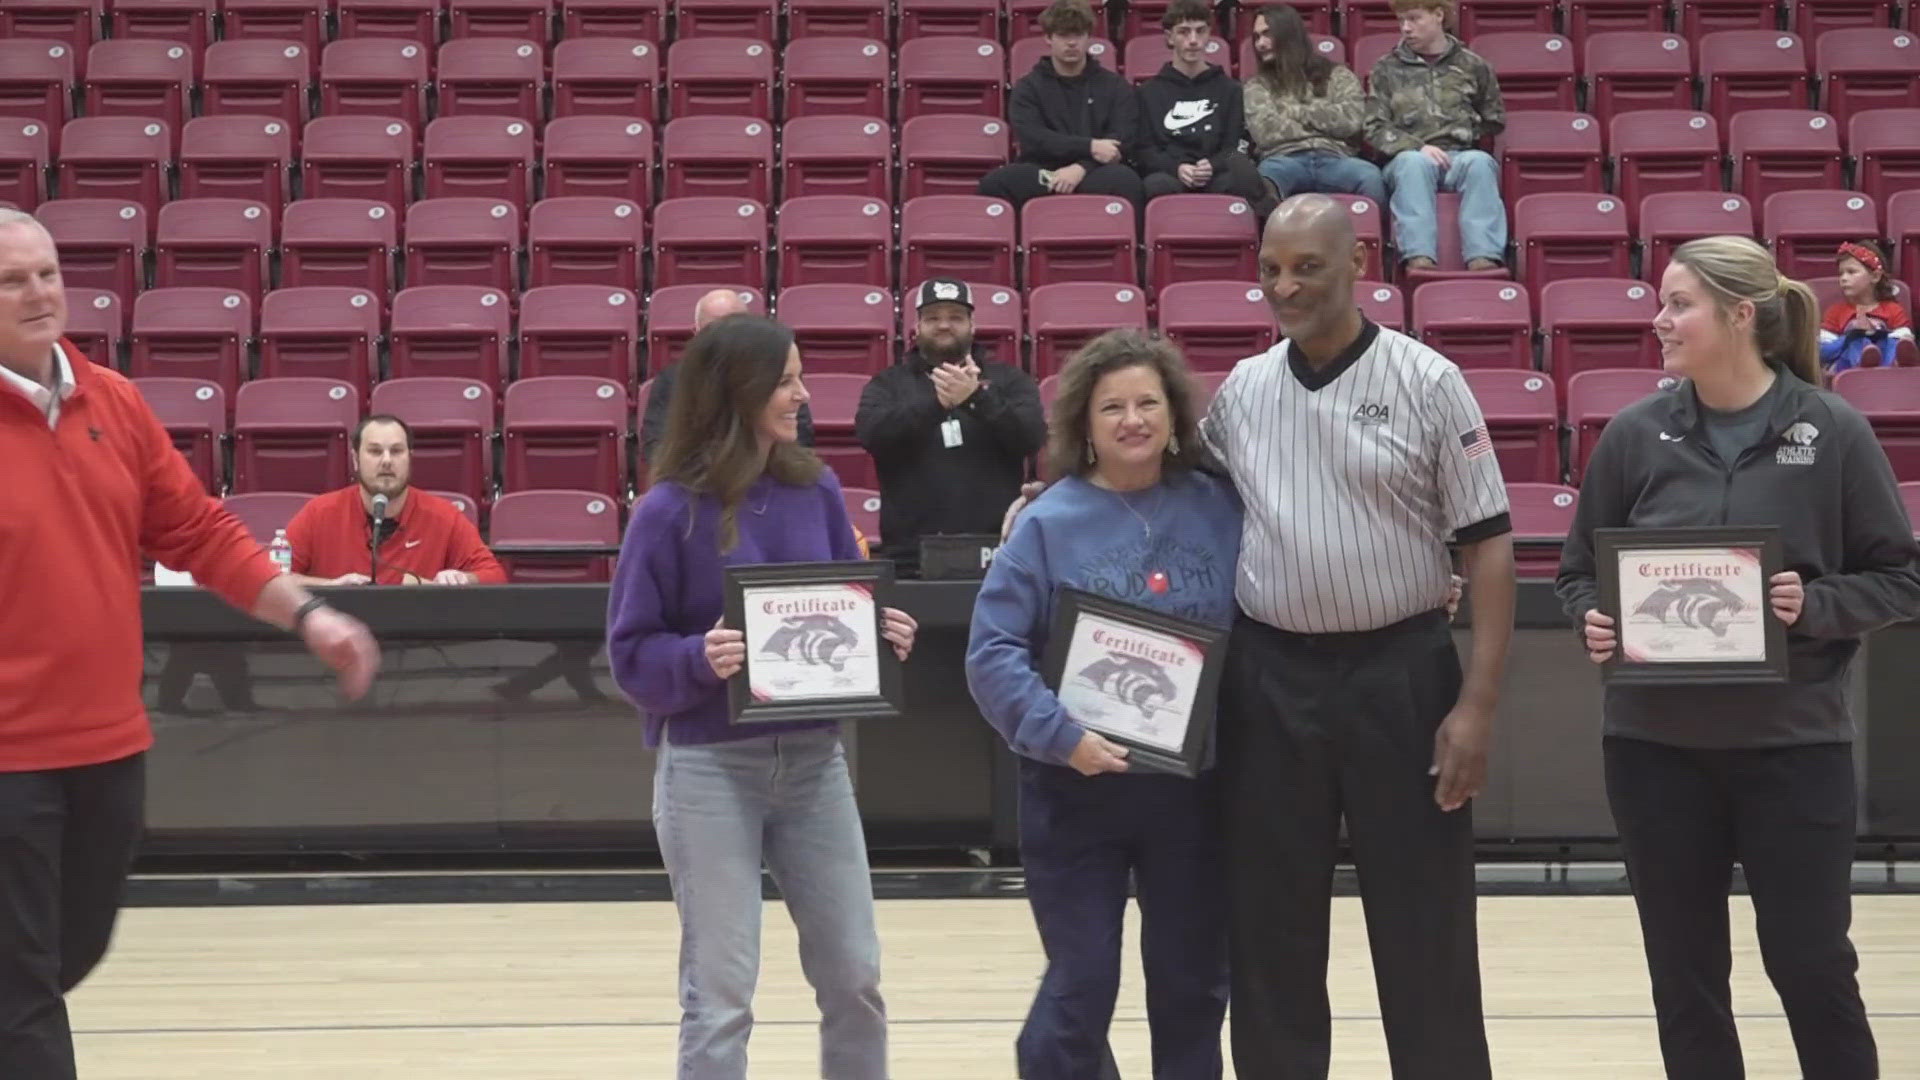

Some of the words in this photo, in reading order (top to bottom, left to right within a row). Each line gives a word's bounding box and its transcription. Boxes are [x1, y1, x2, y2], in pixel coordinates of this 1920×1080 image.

[1354, 403, 1389, 418] AOA
[1777, 446, 1817, 456] ATHLETIC
[1638, 562, 1742, 577] Certificate
[763, 598, 857, 615] Certificate
[1092, 629, 1186, 667] Certificate
